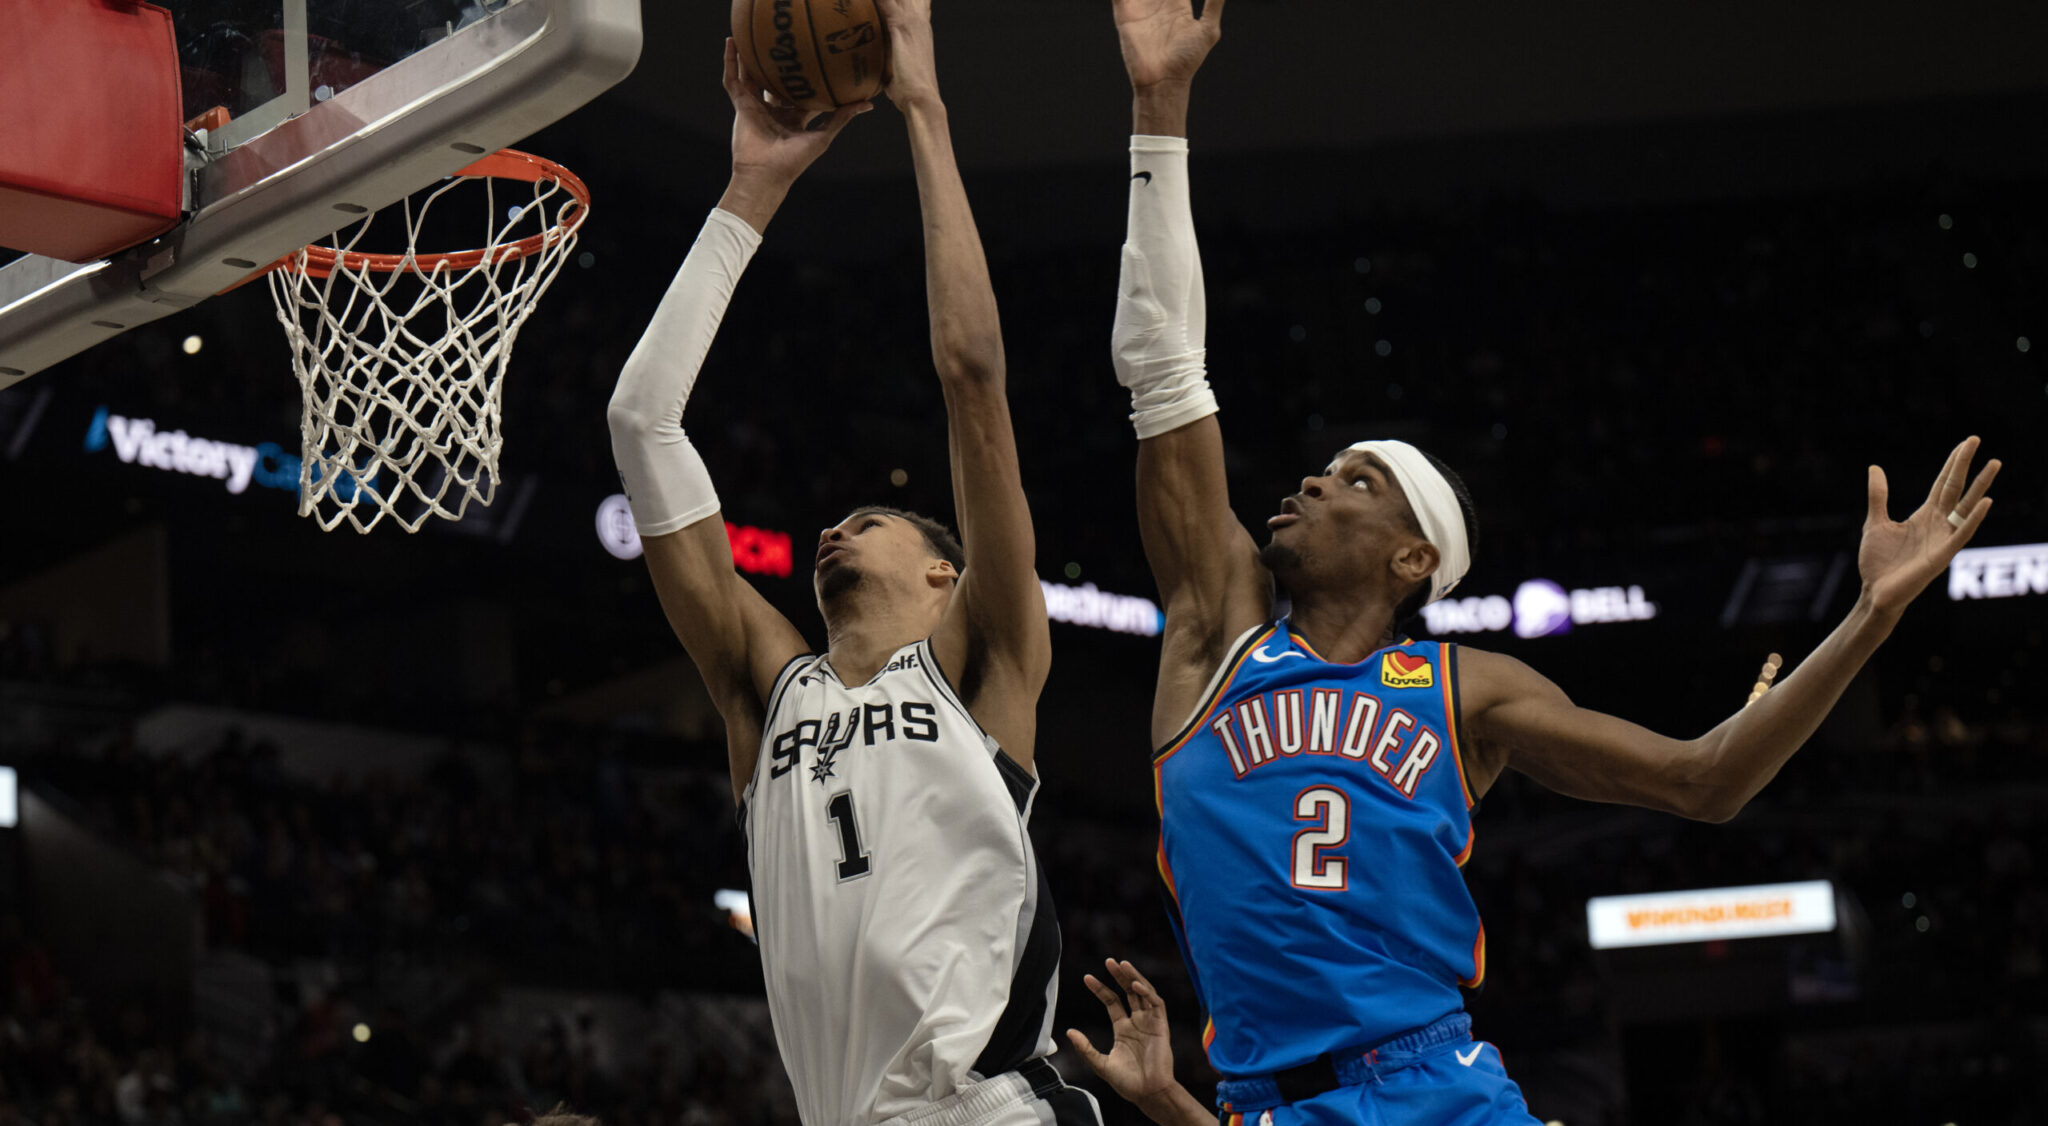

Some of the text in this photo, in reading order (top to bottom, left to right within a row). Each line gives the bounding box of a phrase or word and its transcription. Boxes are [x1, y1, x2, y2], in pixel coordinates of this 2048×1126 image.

[769, 0, 815, 99] Wilson
[1570, 585, 1657, 625] BELL
[885, 653, 919, 672] elf.
[771, 701, 938, 785] SPURS
[1210, 687, 1441, 800] THUNDER
[825, 788, 872, 884] 1
[1291, 784, 1350, 891] 2
